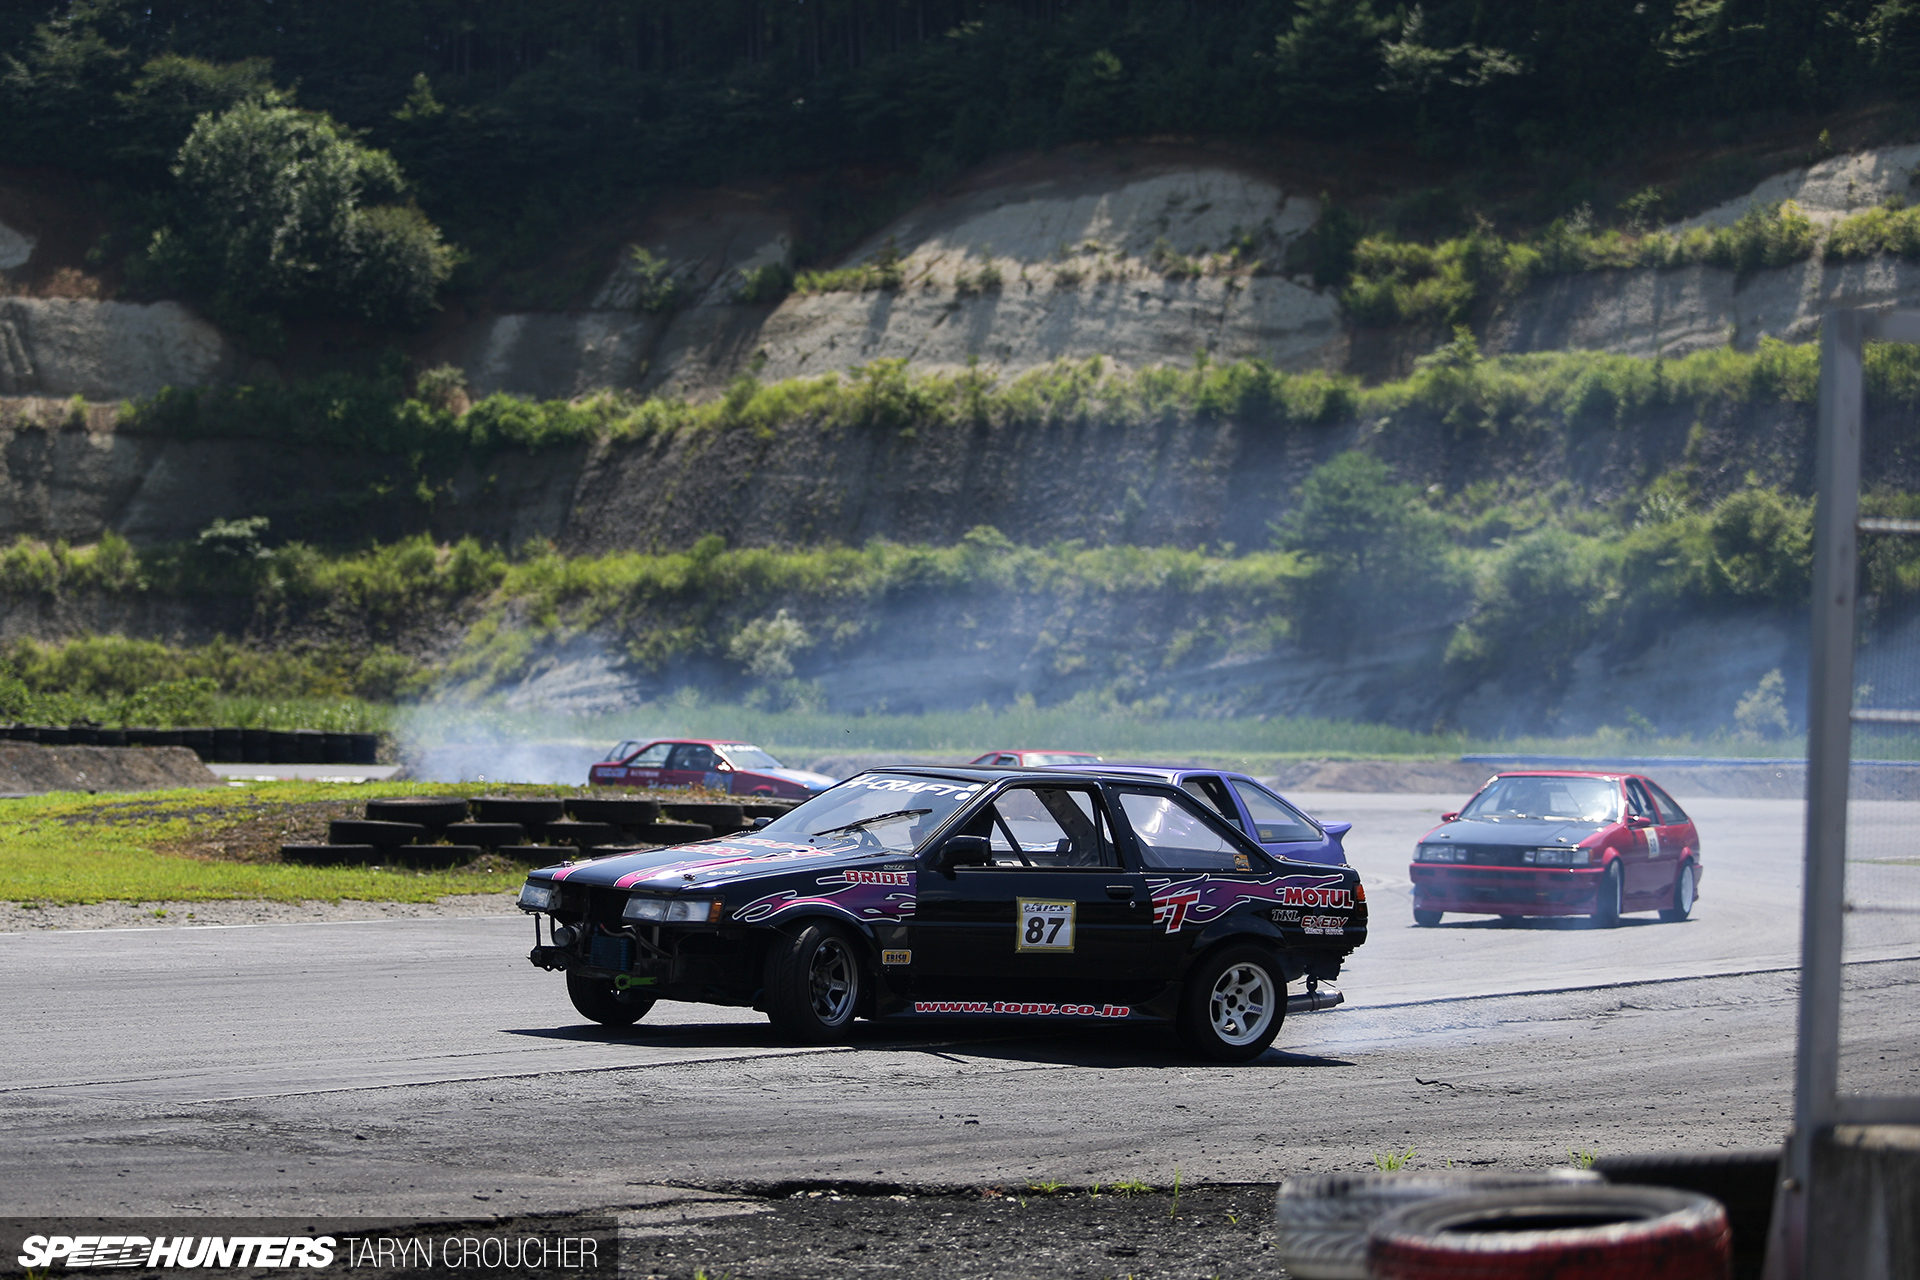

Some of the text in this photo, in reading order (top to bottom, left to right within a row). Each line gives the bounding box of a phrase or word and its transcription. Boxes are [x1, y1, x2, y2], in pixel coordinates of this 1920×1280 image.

[843, 870, 909, 886] BRIDE
[1282, 886, 1354, 909] MOTUL
[1272, 909, 1300, 922] TKL
[1301, 915, 1348, 929] EXEDY
[1025, 916, 1066, 944] 87
[914, 1001, 1130, 1018] www.topy.co.jp
